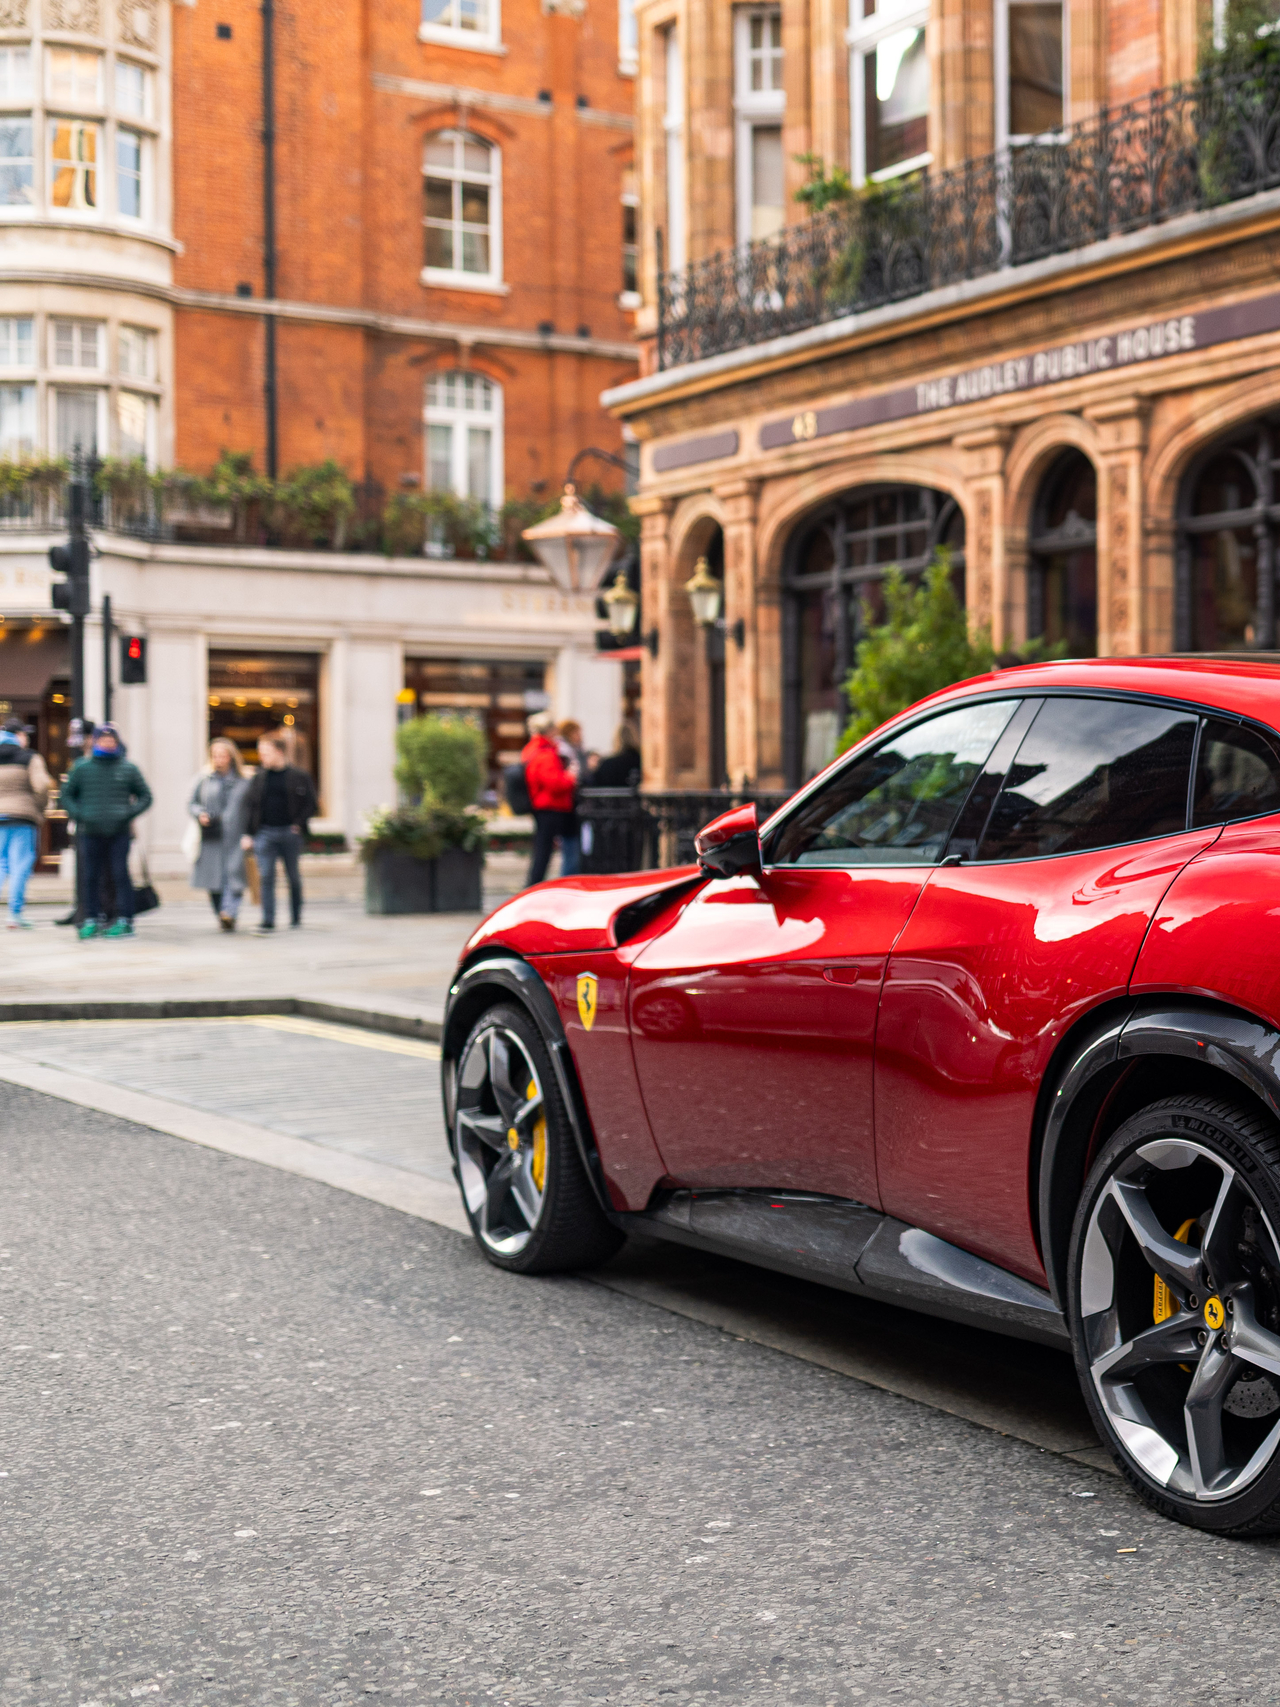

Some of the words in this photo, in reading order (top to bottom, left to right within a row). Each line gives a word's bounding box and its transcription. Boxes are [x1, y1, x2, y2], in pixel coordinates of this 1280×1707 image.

[915, 376, 953, 411] THE
[954, 357, 1031, 402] AUDLEY
[1033, 337, 1112, 383] PUBLIC
[1116, 316, 1196, 364] HOUSE
[1188, 1117, 1255, 1171] MICHELIN
